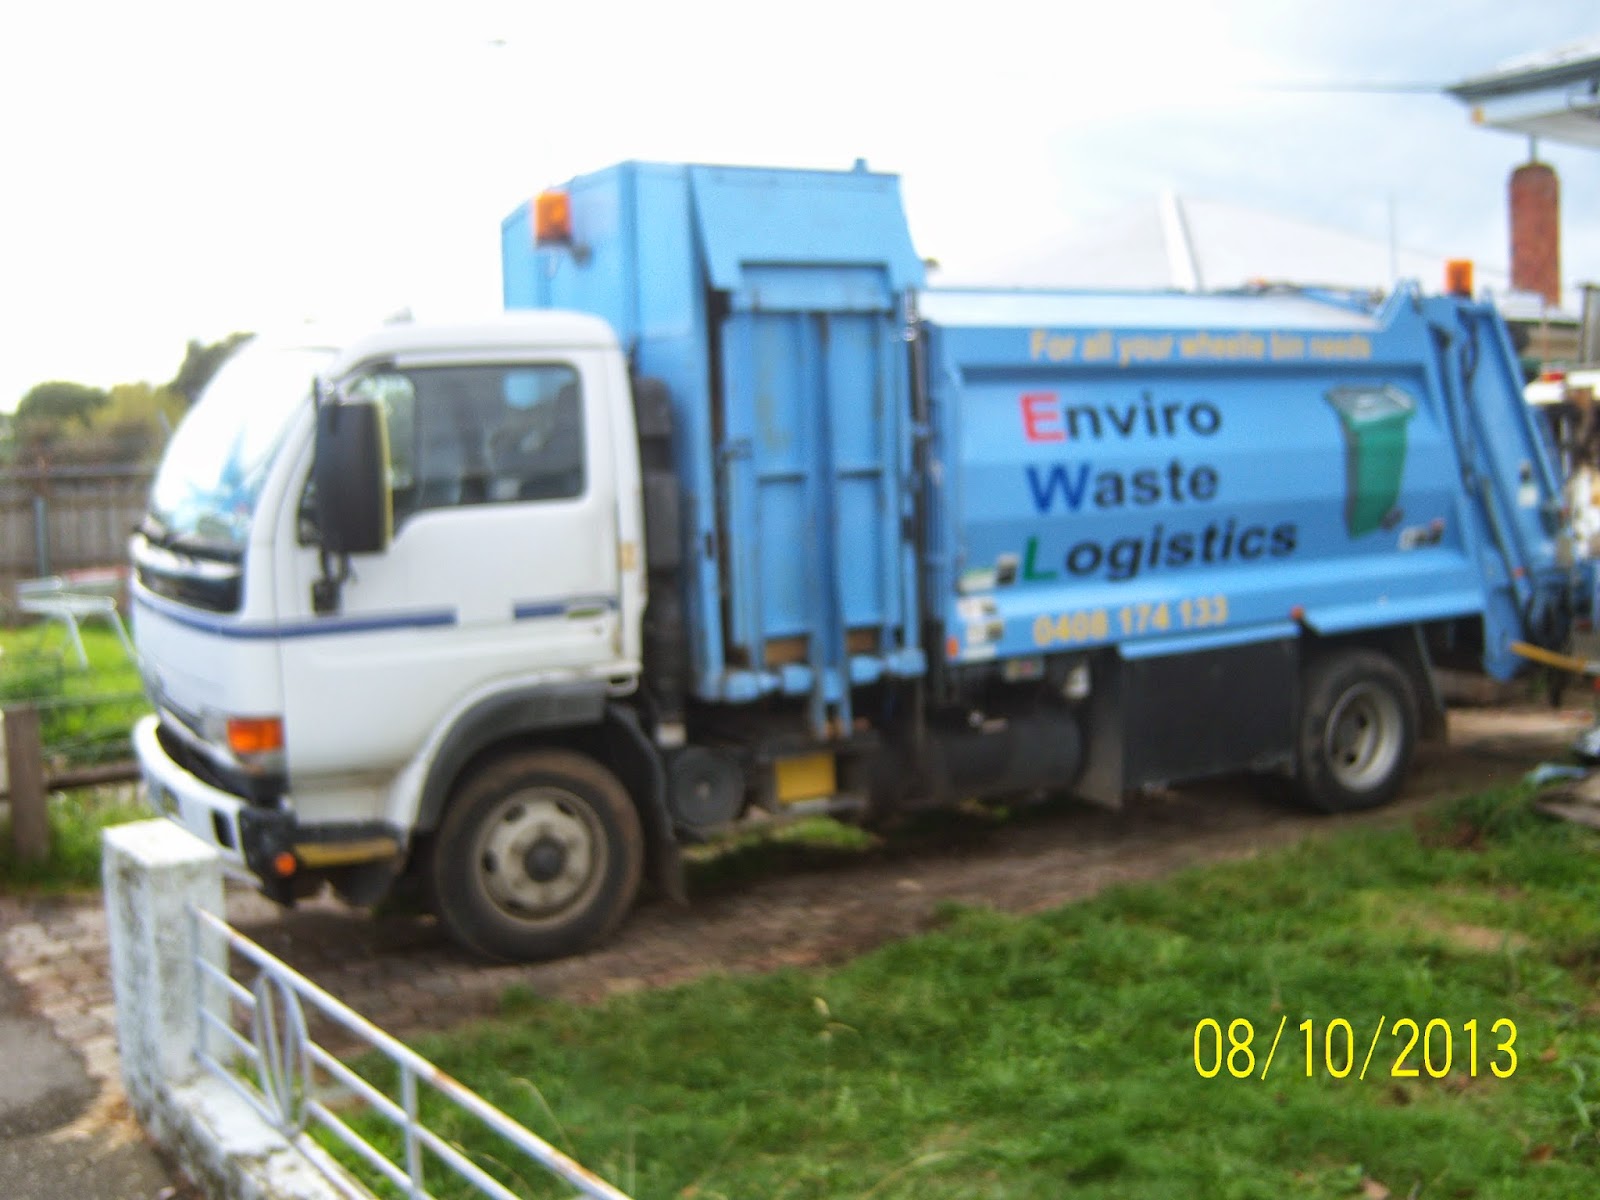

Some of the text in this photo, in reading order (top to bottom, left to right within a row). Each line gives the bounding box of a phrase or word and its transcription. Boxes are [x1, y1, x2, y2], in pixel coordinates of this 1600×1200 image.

[1031, 330, 1074, 362] For
[1083, 331, 1113, 361] all
[1119, 335, 1173, 368] your
[1019, 391, 1222, 443] Enviro
[1024, 459, 1220, 513] Waste
[1022, 518, 1299, 582] Logistics
[1119, 601, 1170, 636] 174
